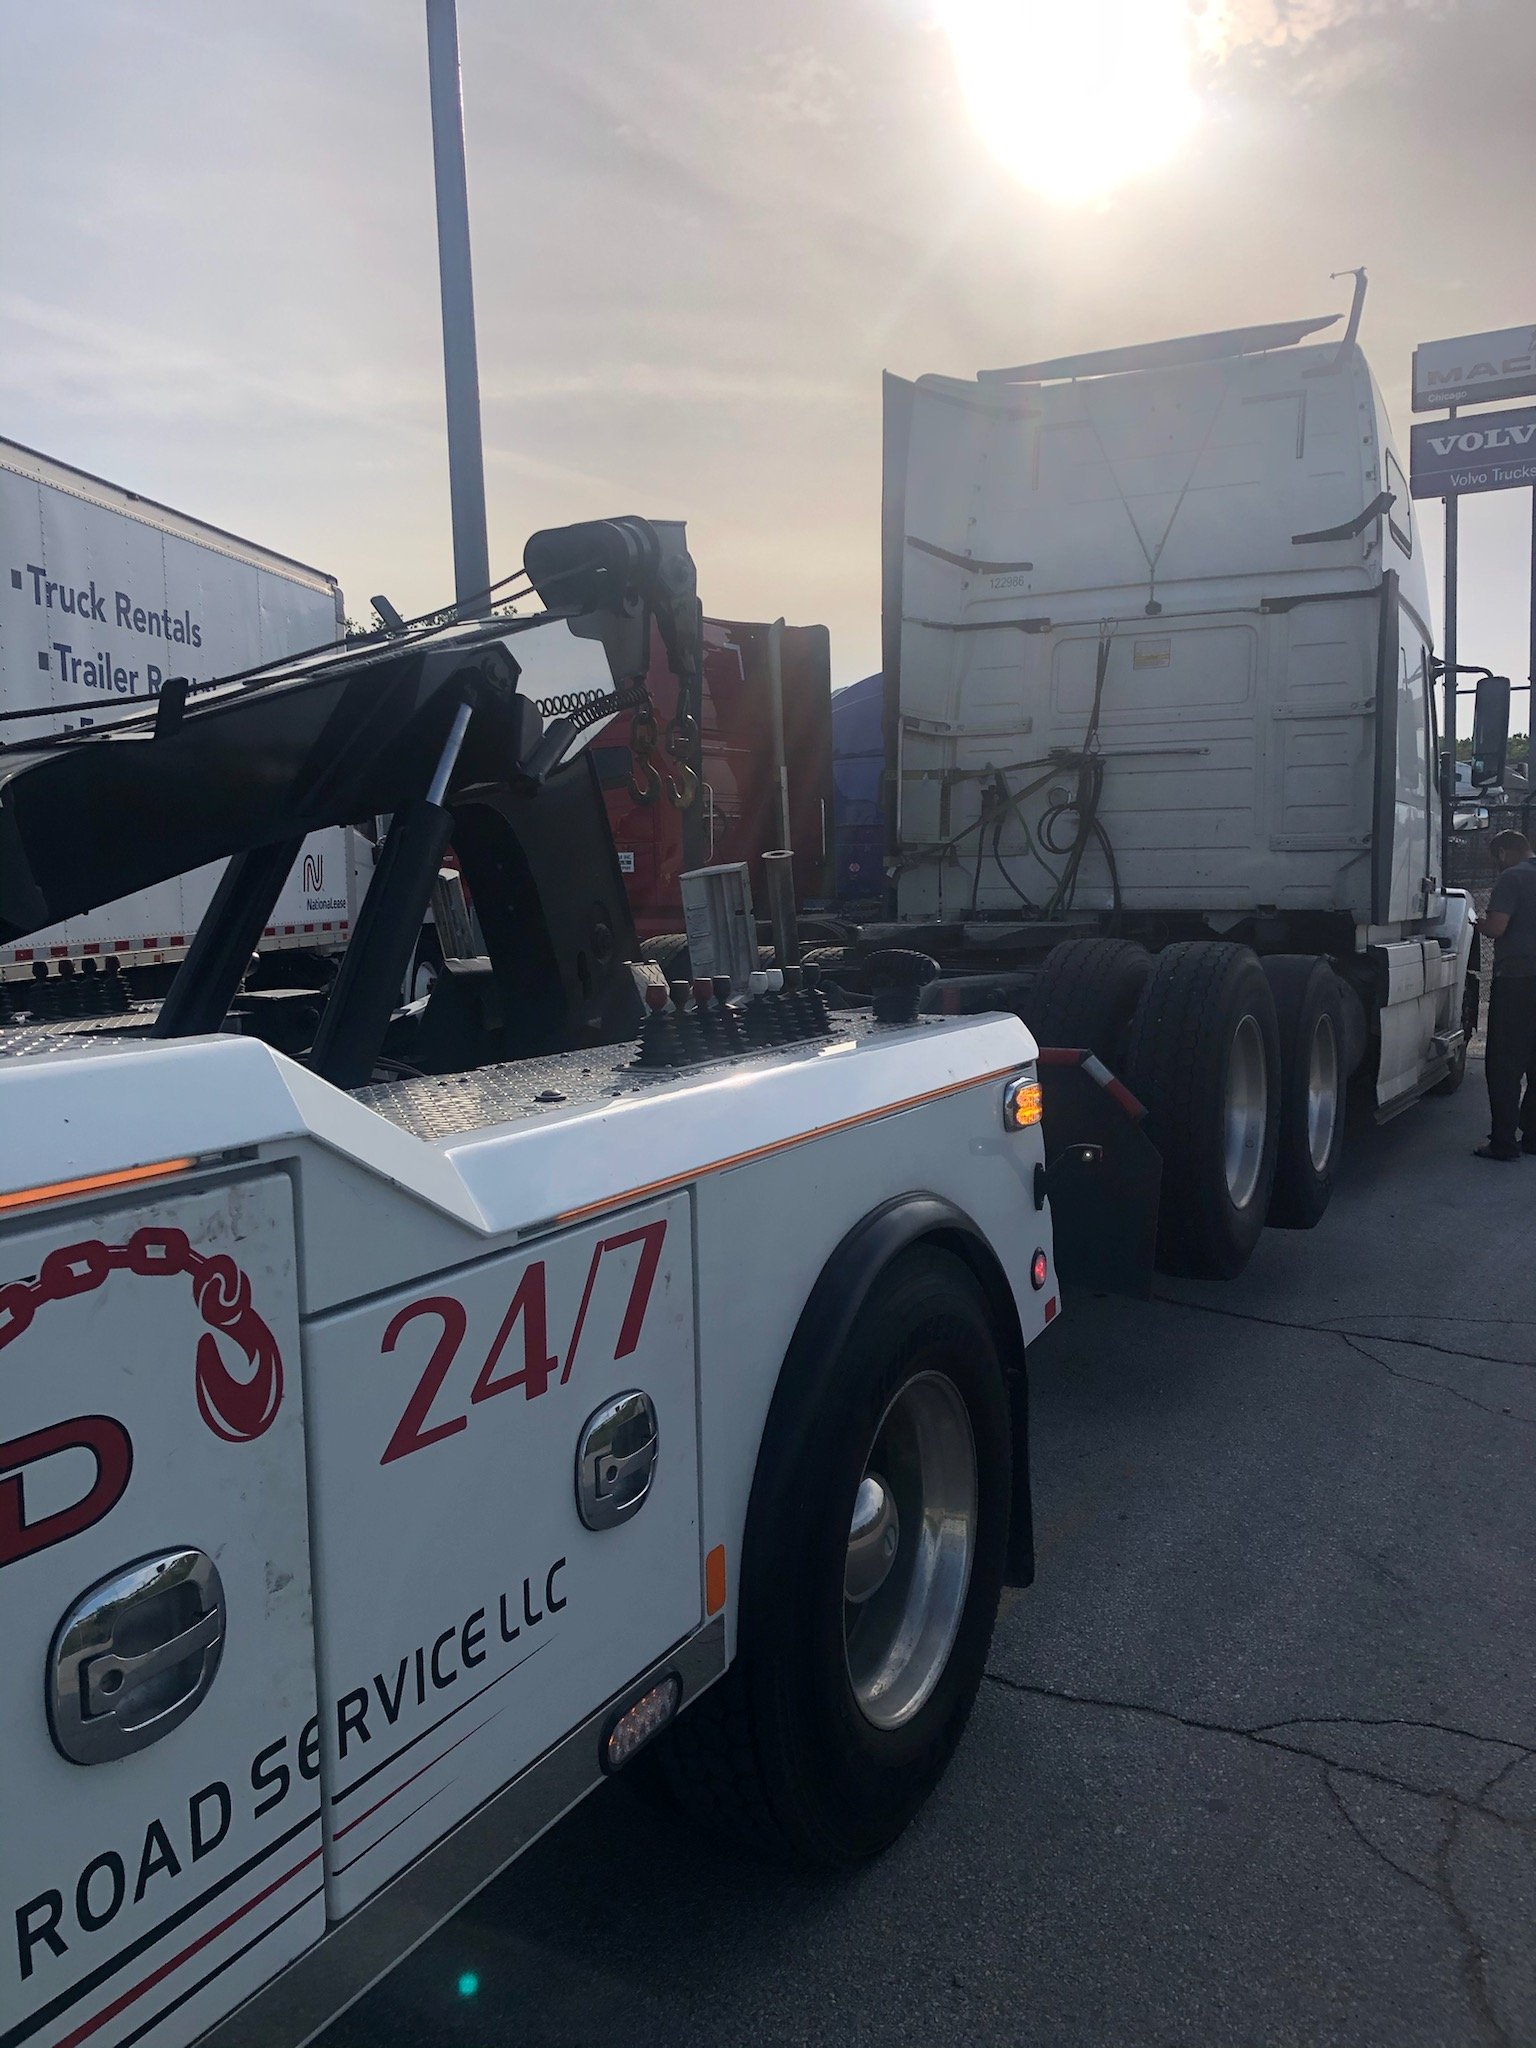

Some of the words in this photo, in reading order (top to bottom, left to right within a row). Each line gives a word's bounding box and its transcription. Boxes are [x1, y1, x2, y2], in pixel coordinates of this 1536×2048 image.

[1427, 355, 1536, 386] MAC
[1428, 391, 1468, 403] Chicago
[1426, 423, 1536, 456] VOLV
[1450, 472, 1488, 487] Volvo
[1492, 464, 1536, 482] Trucks
[990, 575, 1025, 589] 122986
[26, 563, 107, 623] Truck
[115, 591, 202, 648] Rentals
[53, 642, 139, 694] Trailer
[380, 1219, 667, 1466] 24/7
[15, 1781, 232, 1982] ROAD
[251, 1606, 486, 1820] SERVICE
[499, 1556, 567, 1643] LLC
